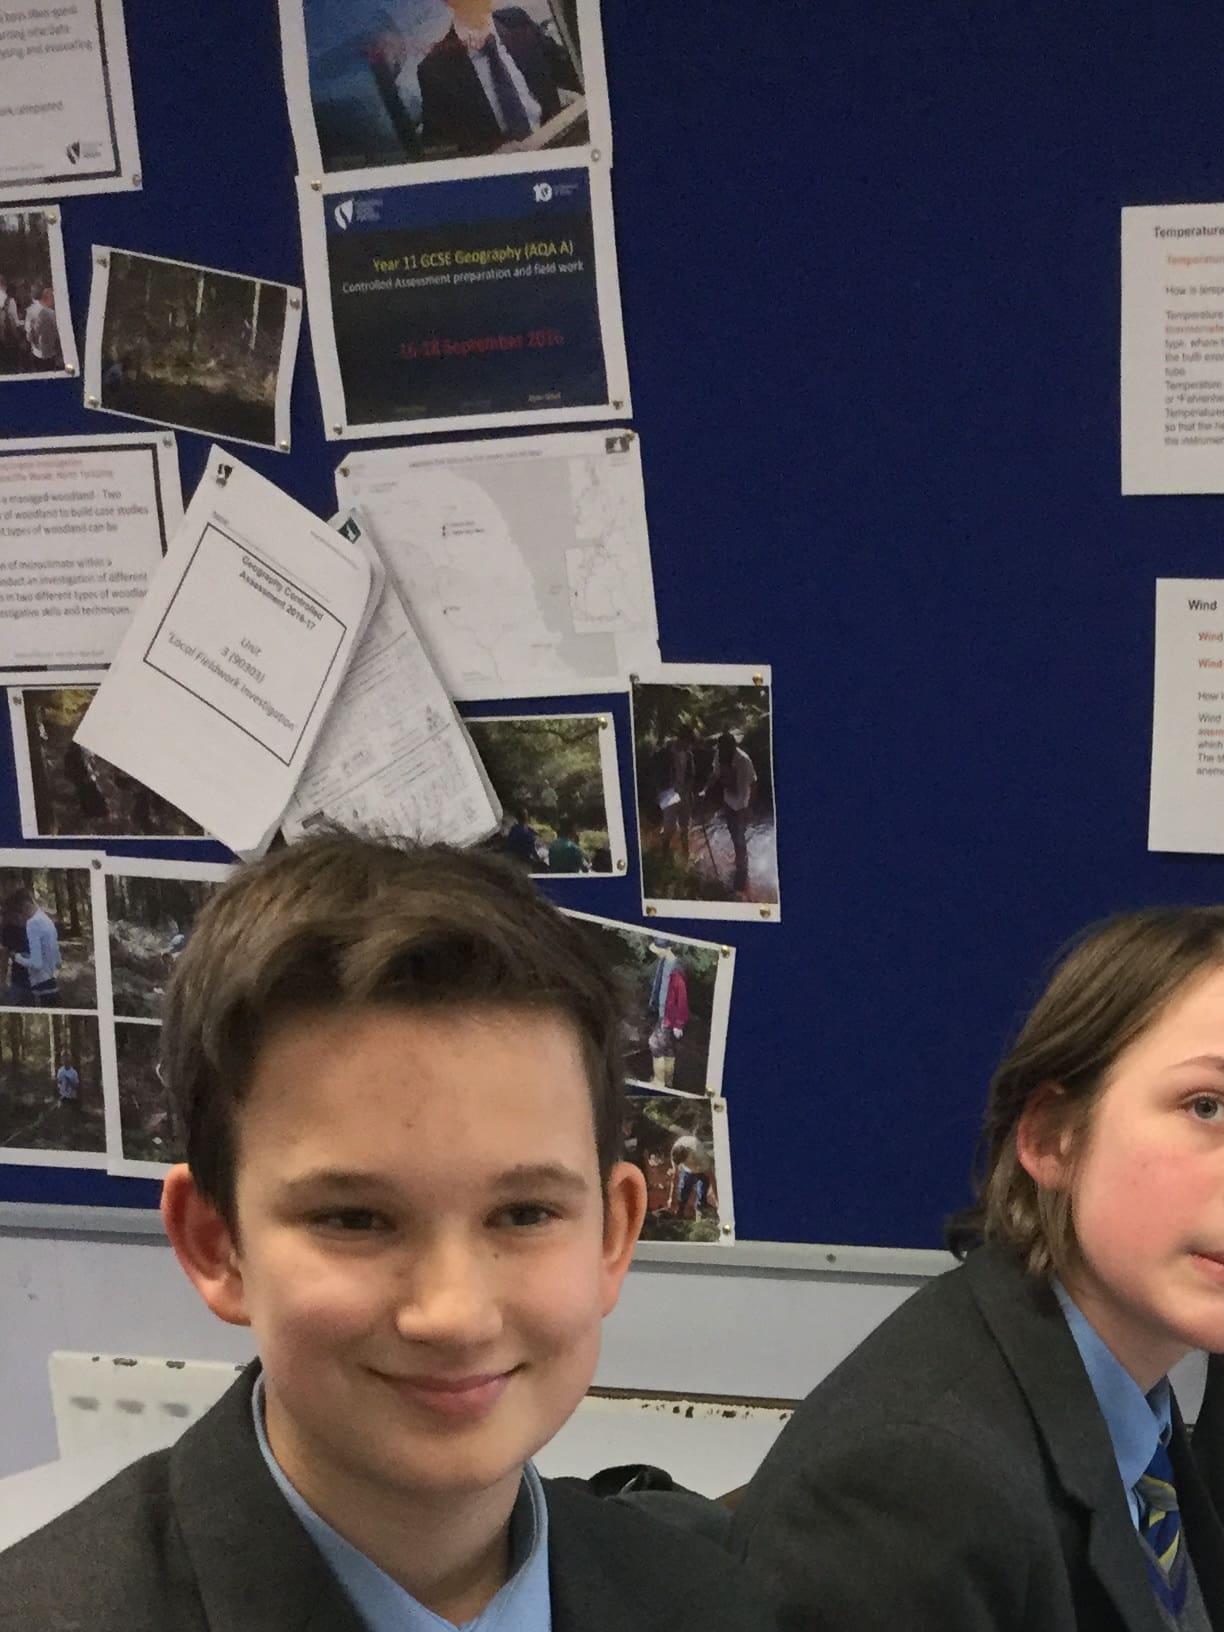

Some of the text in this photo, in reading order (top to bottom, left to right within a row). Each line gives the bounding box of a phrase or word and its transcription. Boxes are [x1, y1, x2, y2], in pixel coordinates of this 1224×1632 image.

[373, 257, 399, 272] Year
[404, 257, 417, 271] 11
[420, 251, 451, 268] GCSE
[455, 245, 521, 266] Geography
[343, 260, 584, 293] Controlled Assessment preparation and field work
[102, 489, 122, 500] Two
[239, 570, 286, 610] Assessment
[242, 555, 324, 621] Geography Controlled
[1188, 600, 1218, 611] Wind
[240, 637, 262, 656] Unit
[1198, 632, 1223, 642] Wind
[195, 650, 241, 688] Fieldwork
[1198, 658, 1222, 669] Wind
[1198, 691, 1218, 701] How
